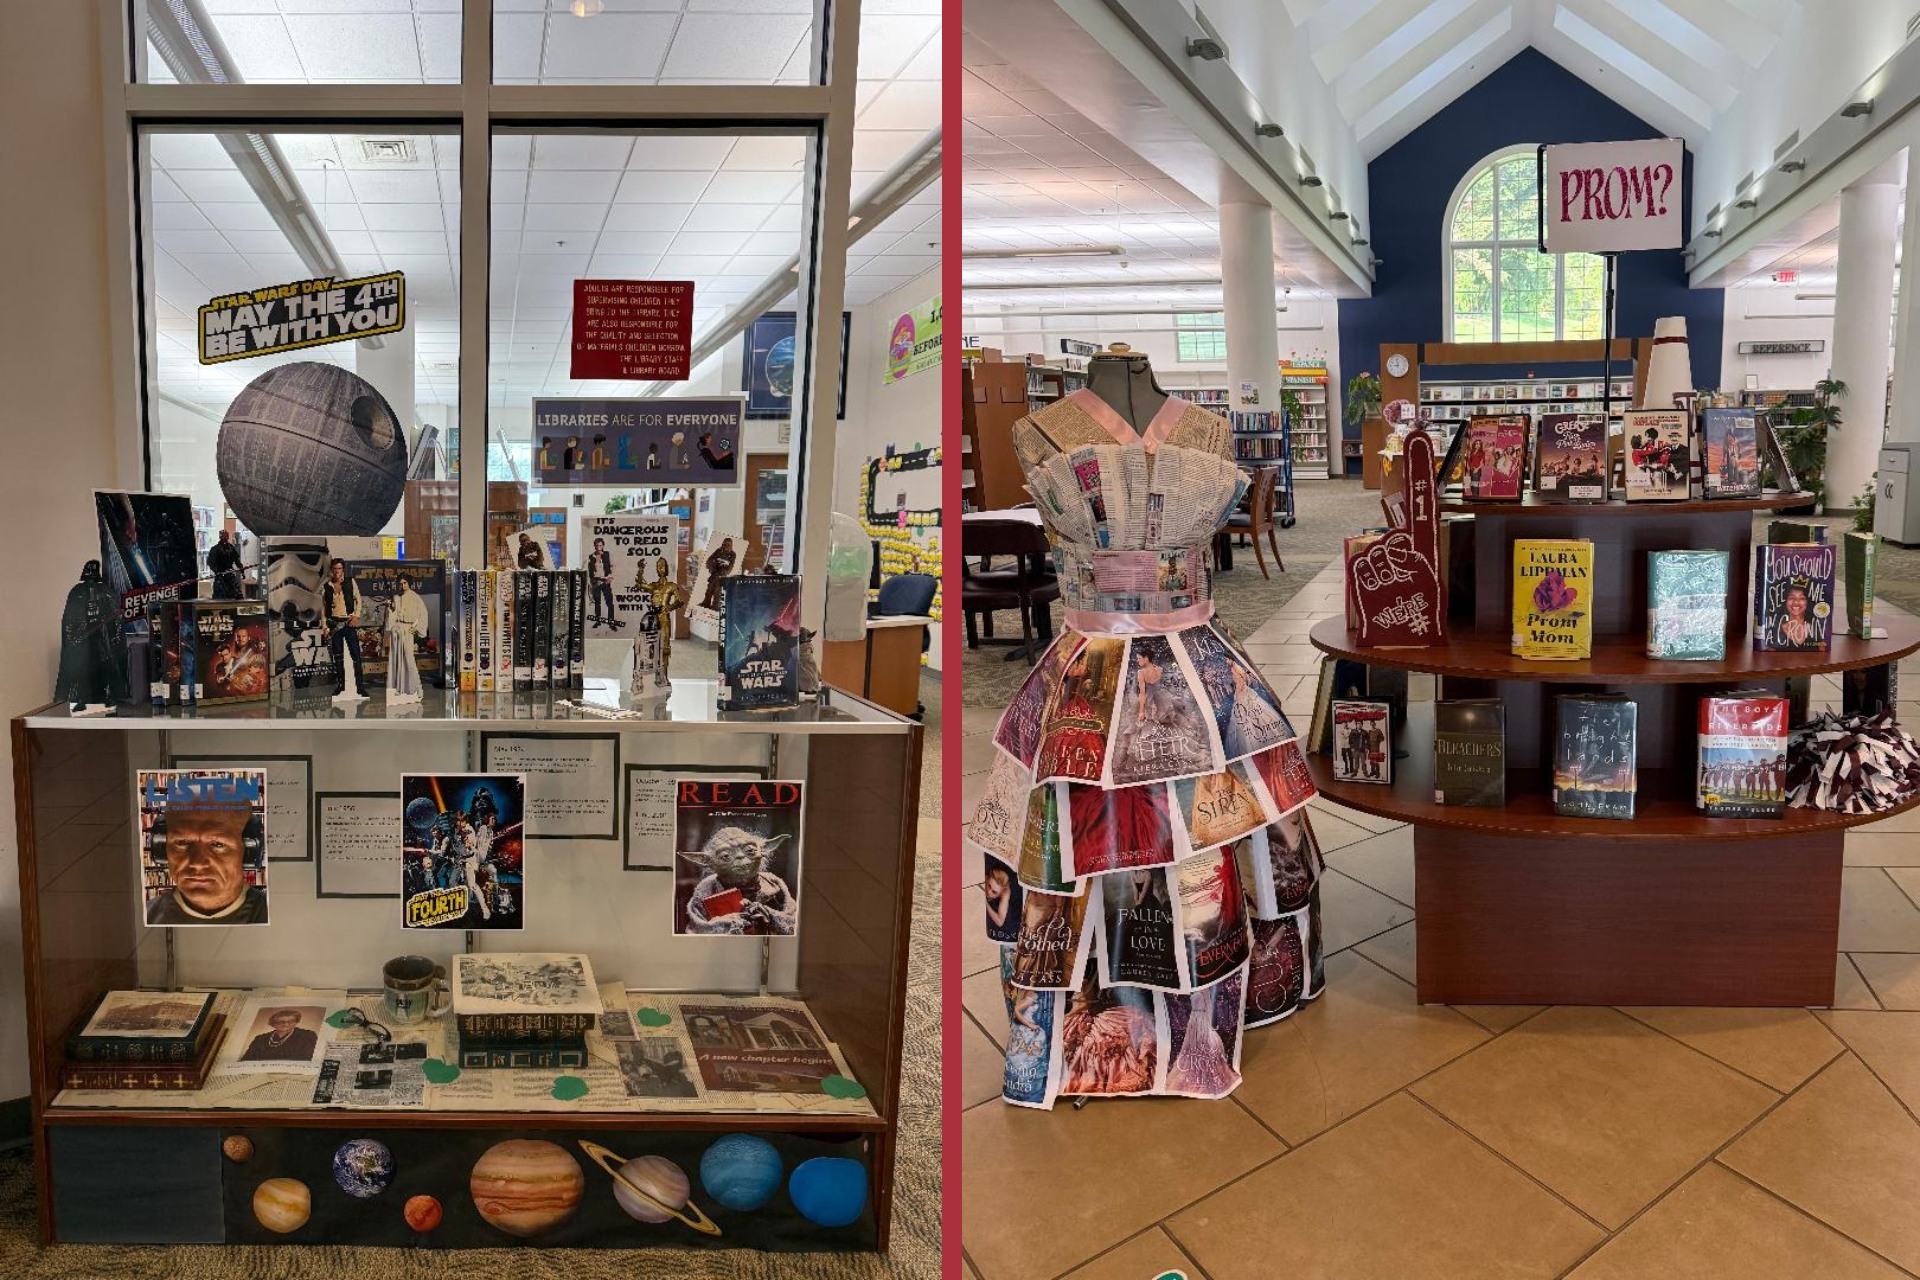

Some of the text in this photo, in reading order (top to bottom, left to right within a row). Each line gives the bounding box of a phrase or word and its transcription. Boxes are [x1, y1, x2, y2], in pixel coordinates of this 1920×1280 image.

[1559, 164, 1673, 222] PROM?
[1777, 271, 1795, 282] EXIT
[210, 278, 334, 310] STAR WARS DAY
[611, 285, 624, 293] ARE
[626, 285, 669, 294] RESPONSIBLE
[671, 286, 685, 294] FOR
[205, 278, 398, 335] MAY THE 4TH
[630, 297, 661, 305] CHILDREN
[204, 302, 398, 358] BE WITH YOU
[587, 320, 679, 329] ARE ALSO RESPONSIBLE FOR
[585, 331, 597, 339] THE
[625, 343, 656, 352] CHILDREN
[1752, 343, 1811, 353] REFERENCE
[630, 367, 656, 375] LIBRARY
[537, 414, 738, 427] LIBRARIES ARE FOR EVERYONE
[597, 517, 616, 525] IT'S
[593, 525, 669, 535] DANGEROUS
[614, 536, 668, 545] TO READ
[626, 547, 662, 556] SOLO
[1530, 553, 1578, 564] LAURA
[1766, 548, 1832, 583] YOU SHOULD
[1520, 566, 1587, 578] LIPPMAN
[125, 586, 179, 608] REVENGE
[1769, 581, 1827, 613] SEE ME
[124, 607, 140, 618] OF
[198, 615, 234, 624] STAR
[1527, 613, 1578, 629] Prom
[198, 623, 235, 633] WARS
[1777, 614, 1827, 648] CROWN
[1530, 630, 1574, 645] Mom
[740, 660, 784, 673] STAR
[740, 676, 784, 690] WARS
[1745, 705, 1779, 713] BOYS
[1436, 739, 1501, 757] BLEACHERS
[1567, 749, 1628, 763] lands
[680, 781, 799, 805] READ
[411, 890, 465, 922] FOURTH
[1117, 908, 1174, 925] FALLEN
[1131, 935, 1166, 951] LOVE
[1029, 974, 1062, 984] CASS
[742, 1054, 788, 1065] chapter
